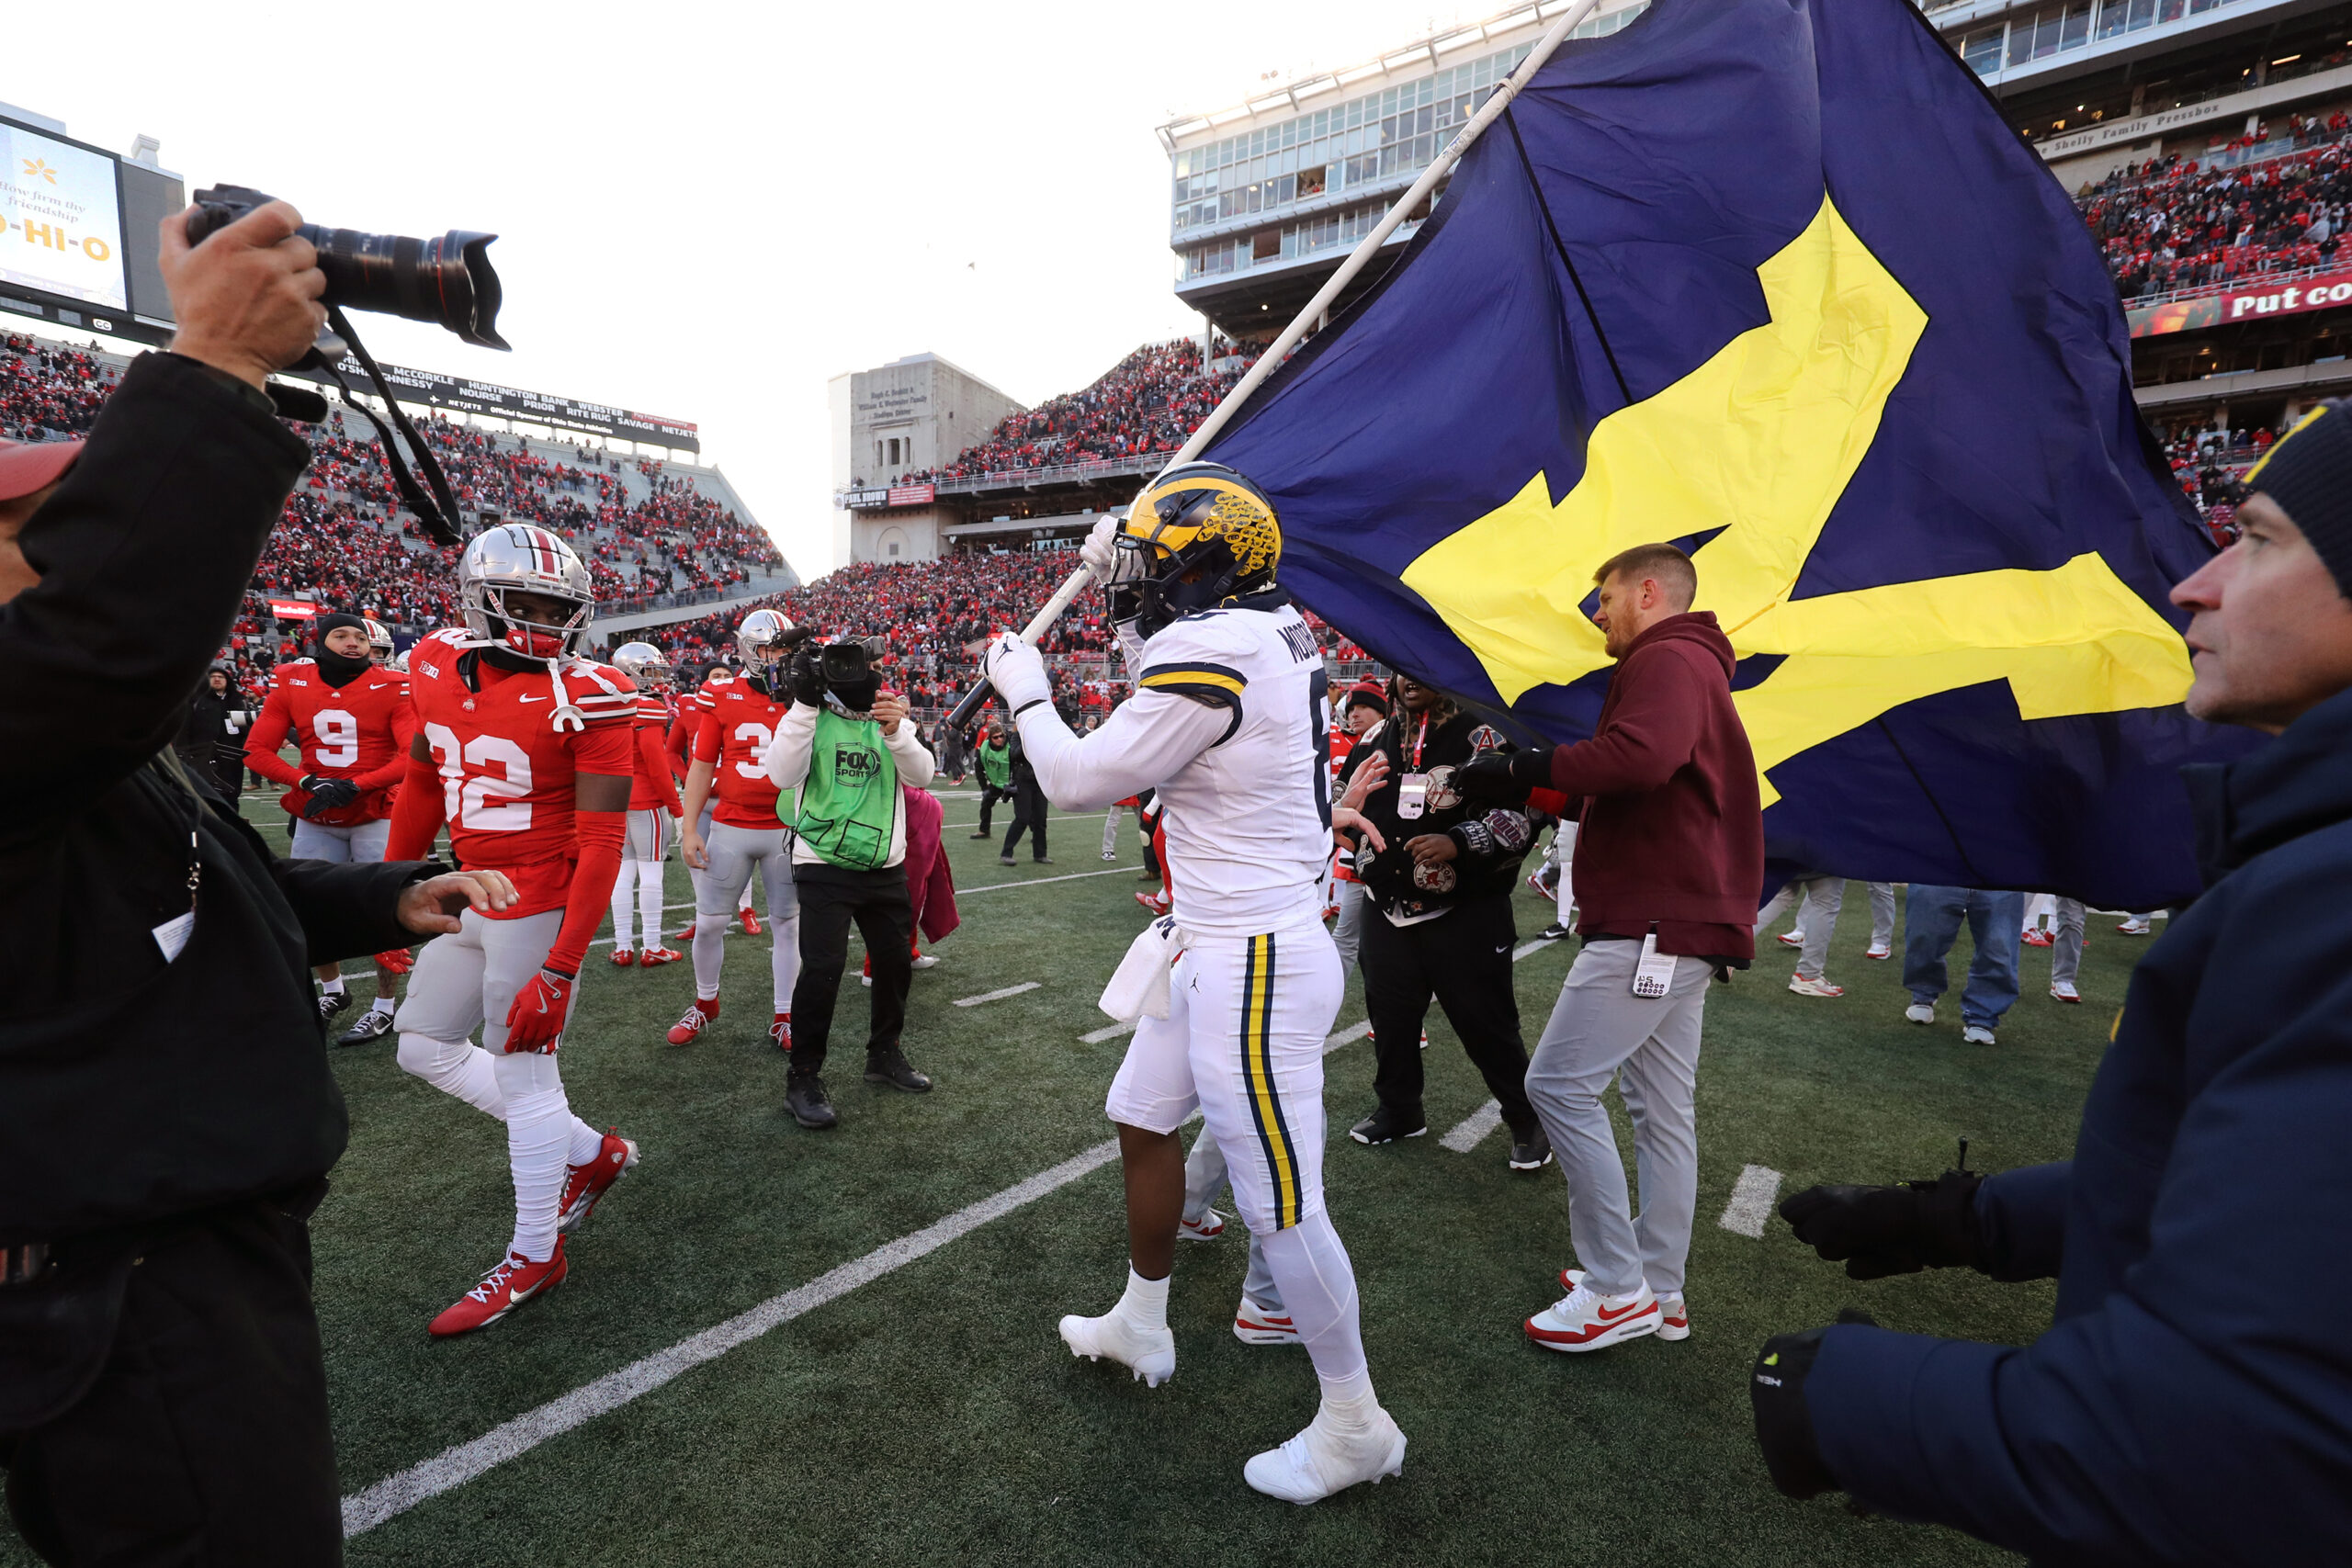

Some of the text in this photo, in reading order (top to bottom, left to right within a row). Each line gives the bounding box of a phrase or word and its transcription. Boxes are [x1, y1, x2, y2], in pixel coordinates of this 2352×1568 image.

[2054, 133, 2095, 152] Shelly
[2102, 120, 2149, 140] Family
[2157, 104, 2219, 127] Pressbox
[6, 195, 79, 224] friendship
[30, 190, 62, 207] firm
[65, 200, 86, 214] thy
[2231, 287, 2302, 318] Put
[96, 321, 110, 330] CC
[458, 388, 503, 403] NOURSE
[523, 399, 556, 412] PRIOR
[566, 407, 589, 419] RITE
[591, 412, 612, 423] RUG
[617, 417, 655, 432] SAVAGE
[468, 380, 537, 401] HUNTINGTON
[540, 394, 570, 407] BANK
[578, 401, 625, 417] WEBSTER
[447, 399, 482, 411] NETJETS
[490, 406, 515, 417] Official
[516, 411, 542, 423] Sponsor
[551, 417, 567, 426] Ohio
[567, 420, 584, 430] State
[584, 423, 614, 434] Athletics
[862, 491, 887, 502] BROWN
[312, 709, 359, 768] 9
[835, 768, 871, 778] SPORTS
[836, 750, 871, 771] FOX
